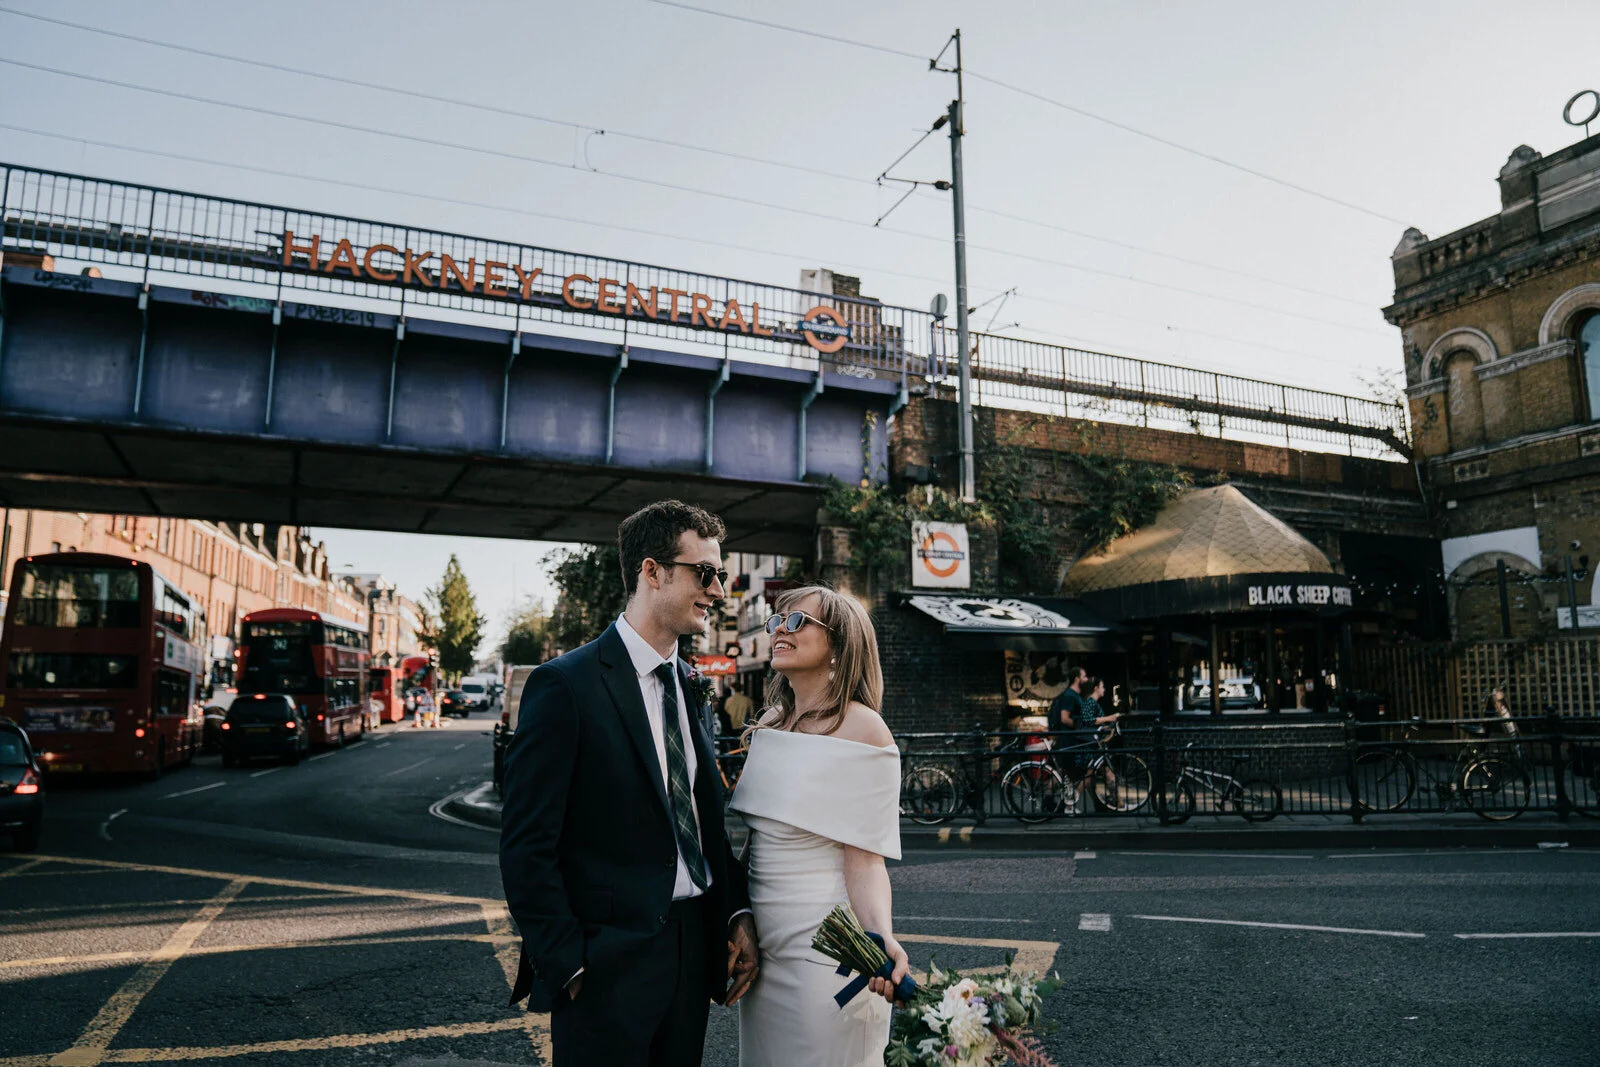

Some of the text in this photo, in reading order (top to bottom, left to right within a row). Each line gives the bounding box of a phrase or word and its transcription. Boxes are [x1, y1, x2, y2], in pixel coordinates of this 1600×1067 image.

[283, 230, 774, 337] HACKNEY CENTRAL
[1248, 585, 1292, 606] BLACK
[1296, 585, 1331, 604] SHEEP
